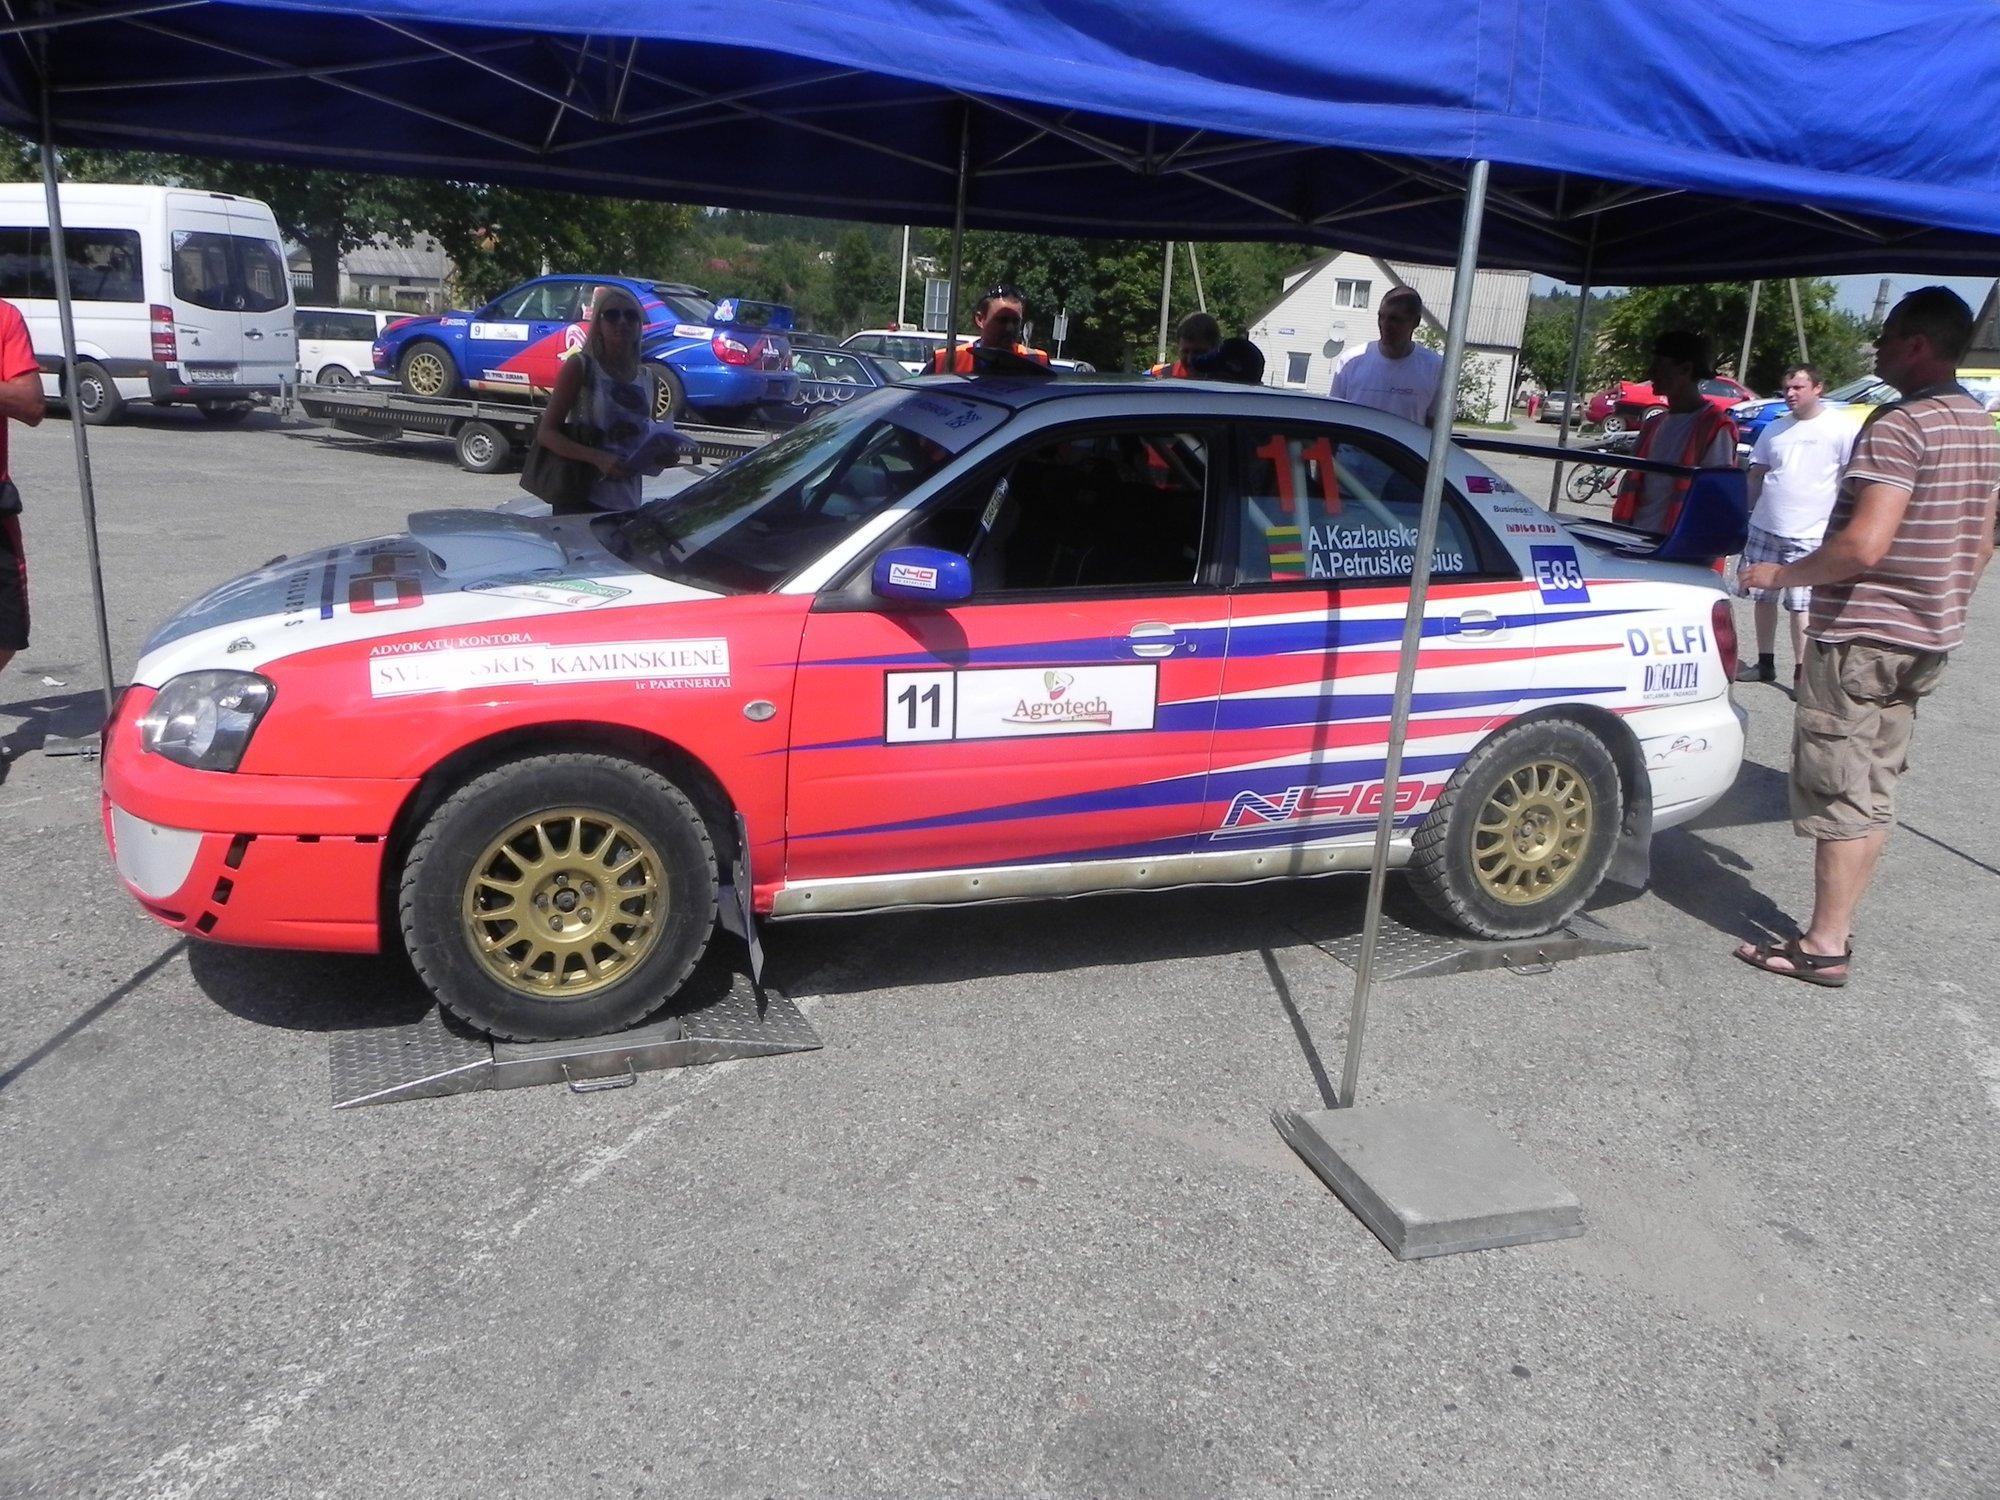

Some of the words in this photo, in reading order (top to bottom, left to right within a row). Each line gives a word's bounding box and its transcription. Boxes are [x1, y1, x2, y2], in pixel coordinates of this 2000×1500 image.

[474, 325, 481, 336] 9
[1256, 434, 1342, 514] 11
[1308, 522, 1418, 551] A.Kazlauska
[1538, 524, 1556, 534] KIDS
[893, 566, 934, 580] N40
[1534, 560, 1583, 590] E85
[458, 632, 533, 647] KONTORA
[1626, 625, 1707, 657] DELFI
[551, 644, 724, 674] KAMINSKIENĖ
[649, 677, 731, 690] PARTNERIAI
[898, 684, 940, 729] 11
[1013, 696, 1108, 723] Agrotech
[1220, 781, 1425, 829] N40
